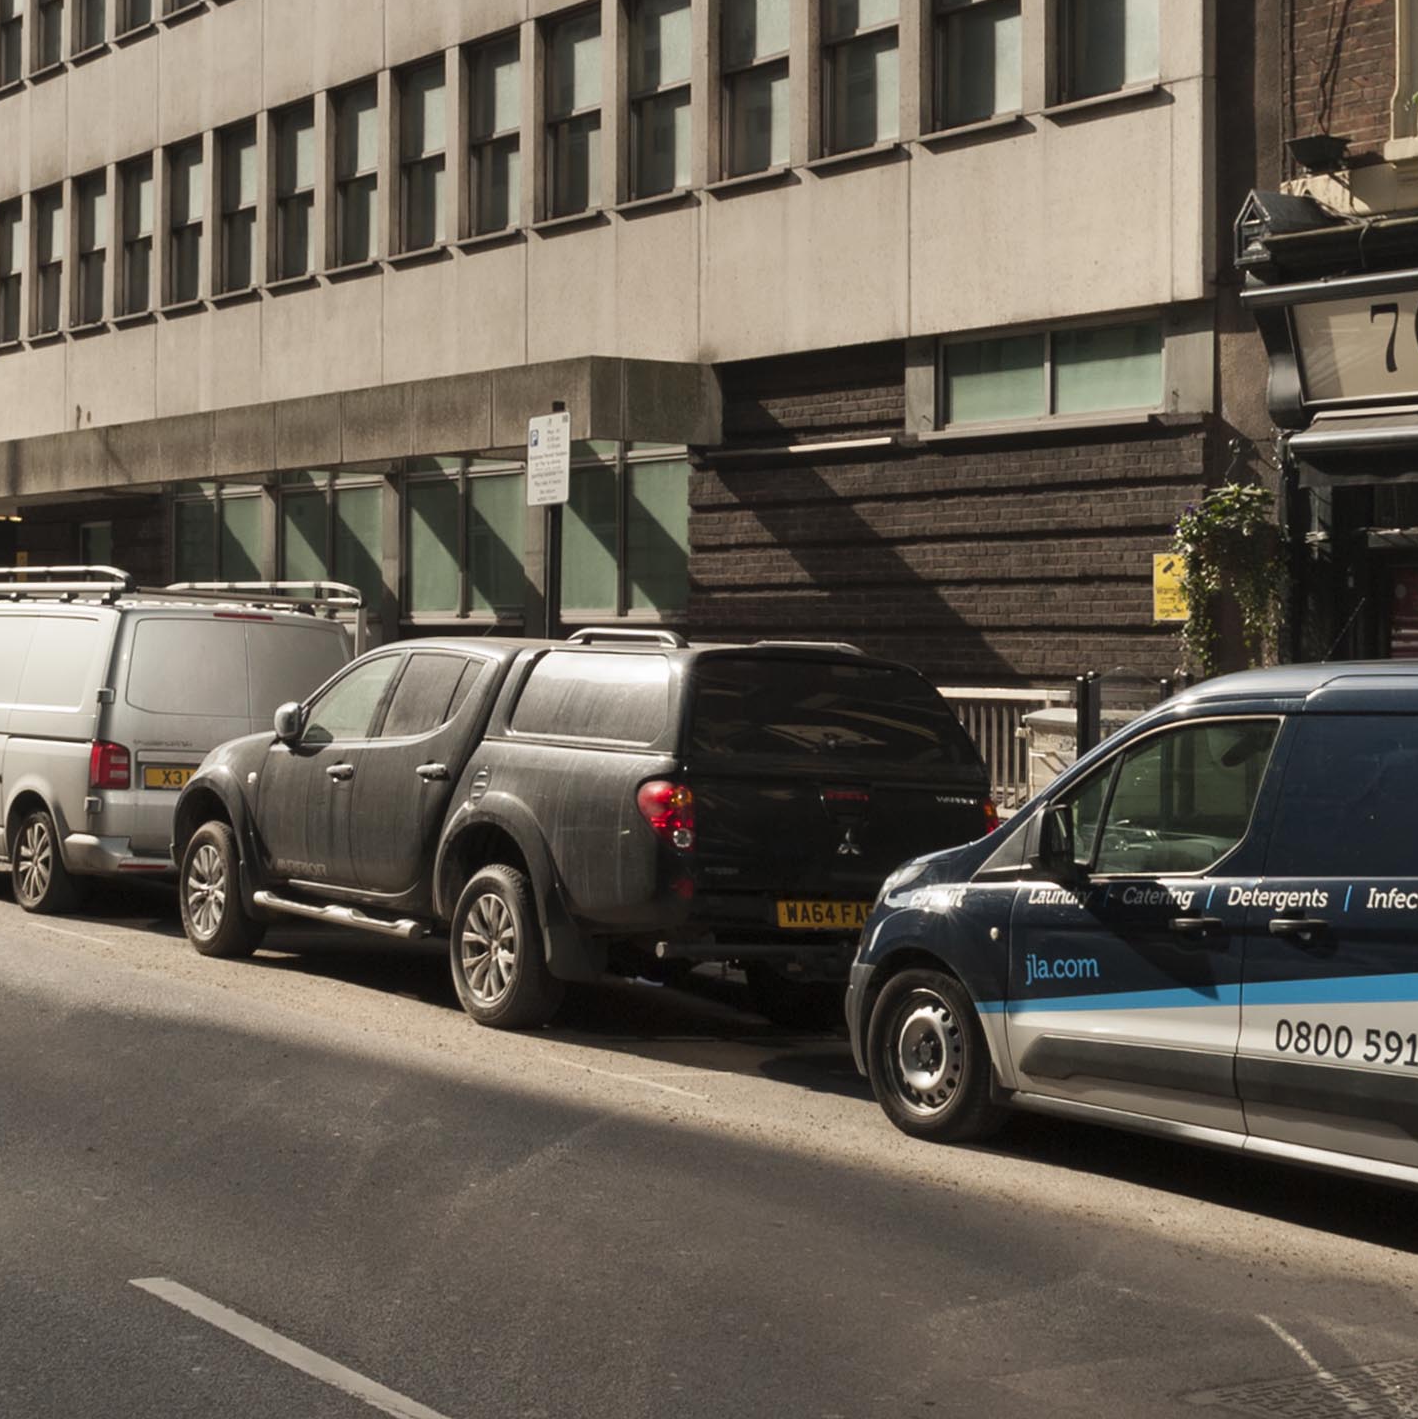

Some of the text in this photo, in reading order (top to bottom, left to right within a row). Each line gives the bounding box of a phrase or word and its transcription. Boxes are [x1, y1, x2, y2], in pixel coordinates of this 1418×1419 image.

[785, 902, 837, 923] WA64
[1028, 886, 1092, 909] Laundry
[1121, 886, 1195, 910] Catering
[1227, 886, 1329, 912] Detergents
[1025, 953, 1100, 985] jla.com
[1274, 1018, 1353, 1059] 0800
